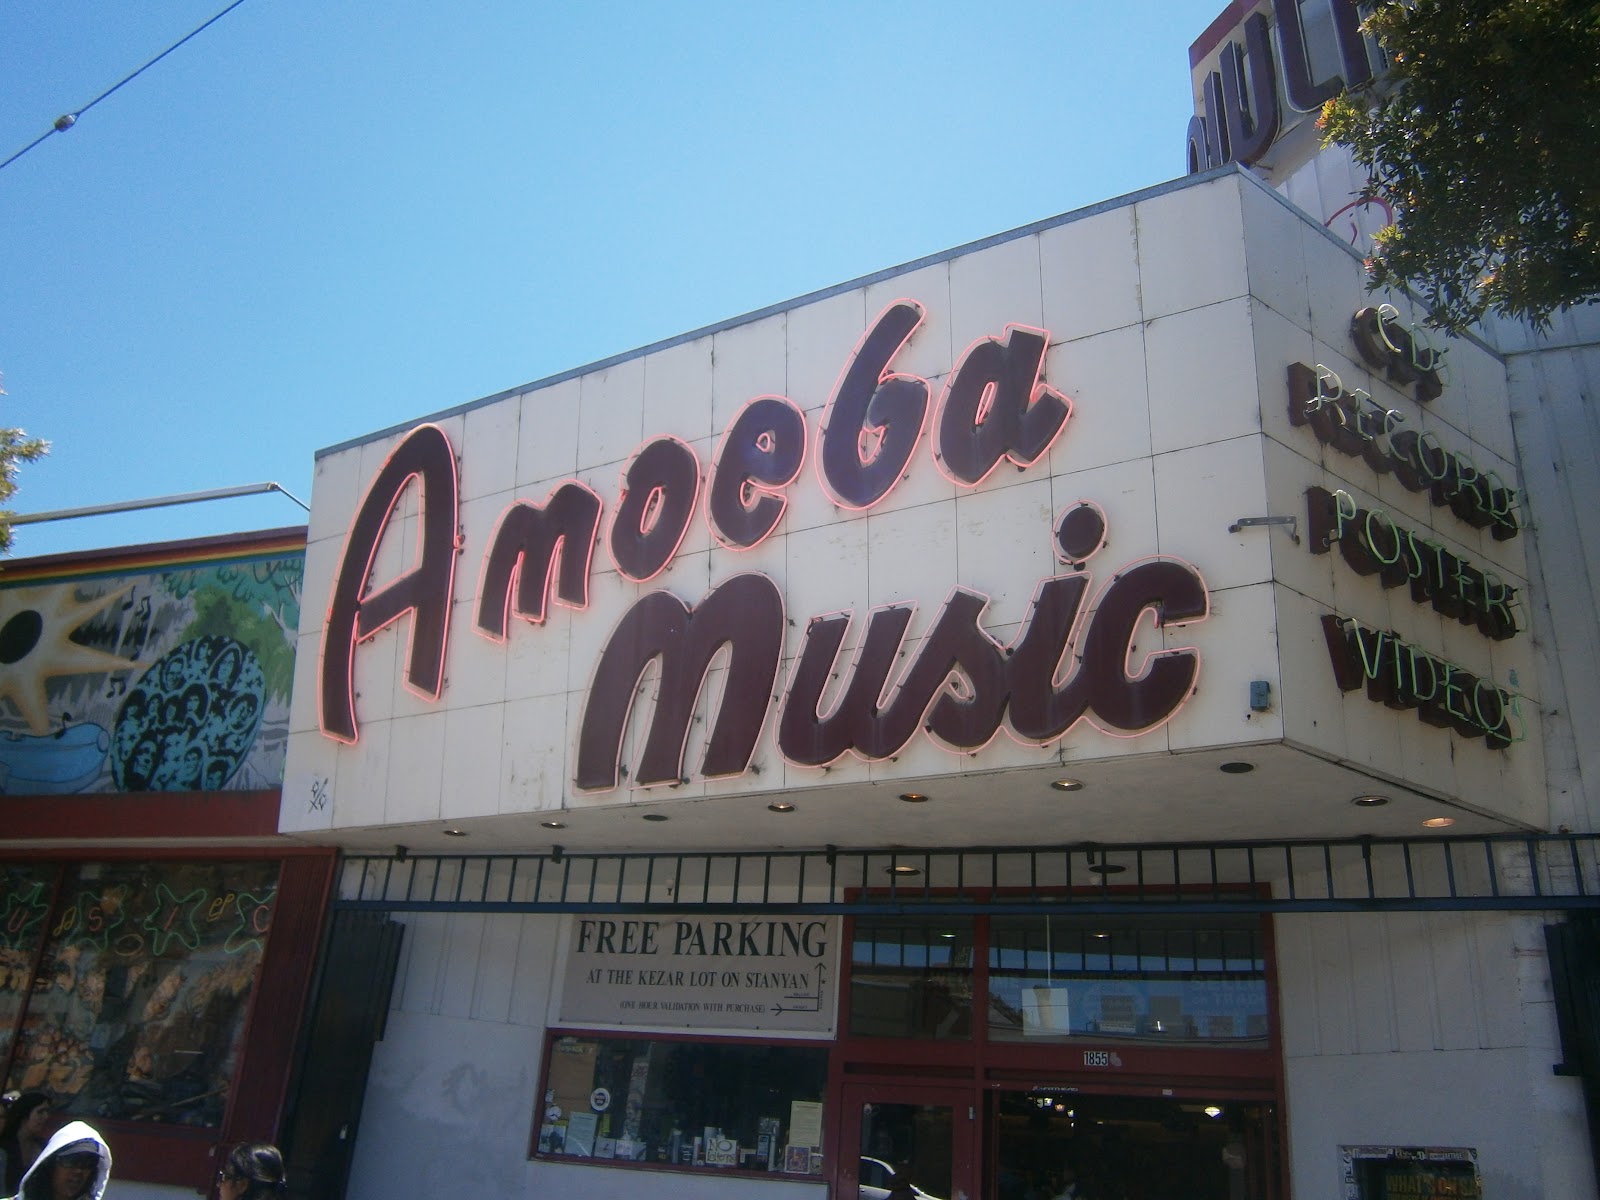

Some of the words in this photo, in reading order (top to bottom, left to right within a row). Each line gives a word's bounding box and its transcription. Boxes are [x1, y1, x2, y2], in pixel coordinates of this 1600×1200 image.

[1288, 362, 1528, 541] RECORDS
[318, 298, 1074, 744] Amoeba
[1307, 488, 1530, 641] POSTERS
[573, 500, 1210, 794] Music
[1322, 614, 1525, 750] VIDEOS
[576, 920, 659, 954] FREE
[671, 920, 827, 958] PARKING
[586, 969, 602, 984] AT
[607, 969, 633, 985] THE
[638, 970, 684, 986] KEZAR
[690, 971, 717, 987] LOT
[721, 972, 740, 988] ON
[745, 973, 809, 989] STANYAN
[638, 1001, 658, 1010] HOUR
[660, 1002, 700, 1011] VALIDATION
[703, 1003, 723, 1012] WITH
[1084, 1051, 1108, 1066] 1855
[708, 1139, 733, 1152] NO
